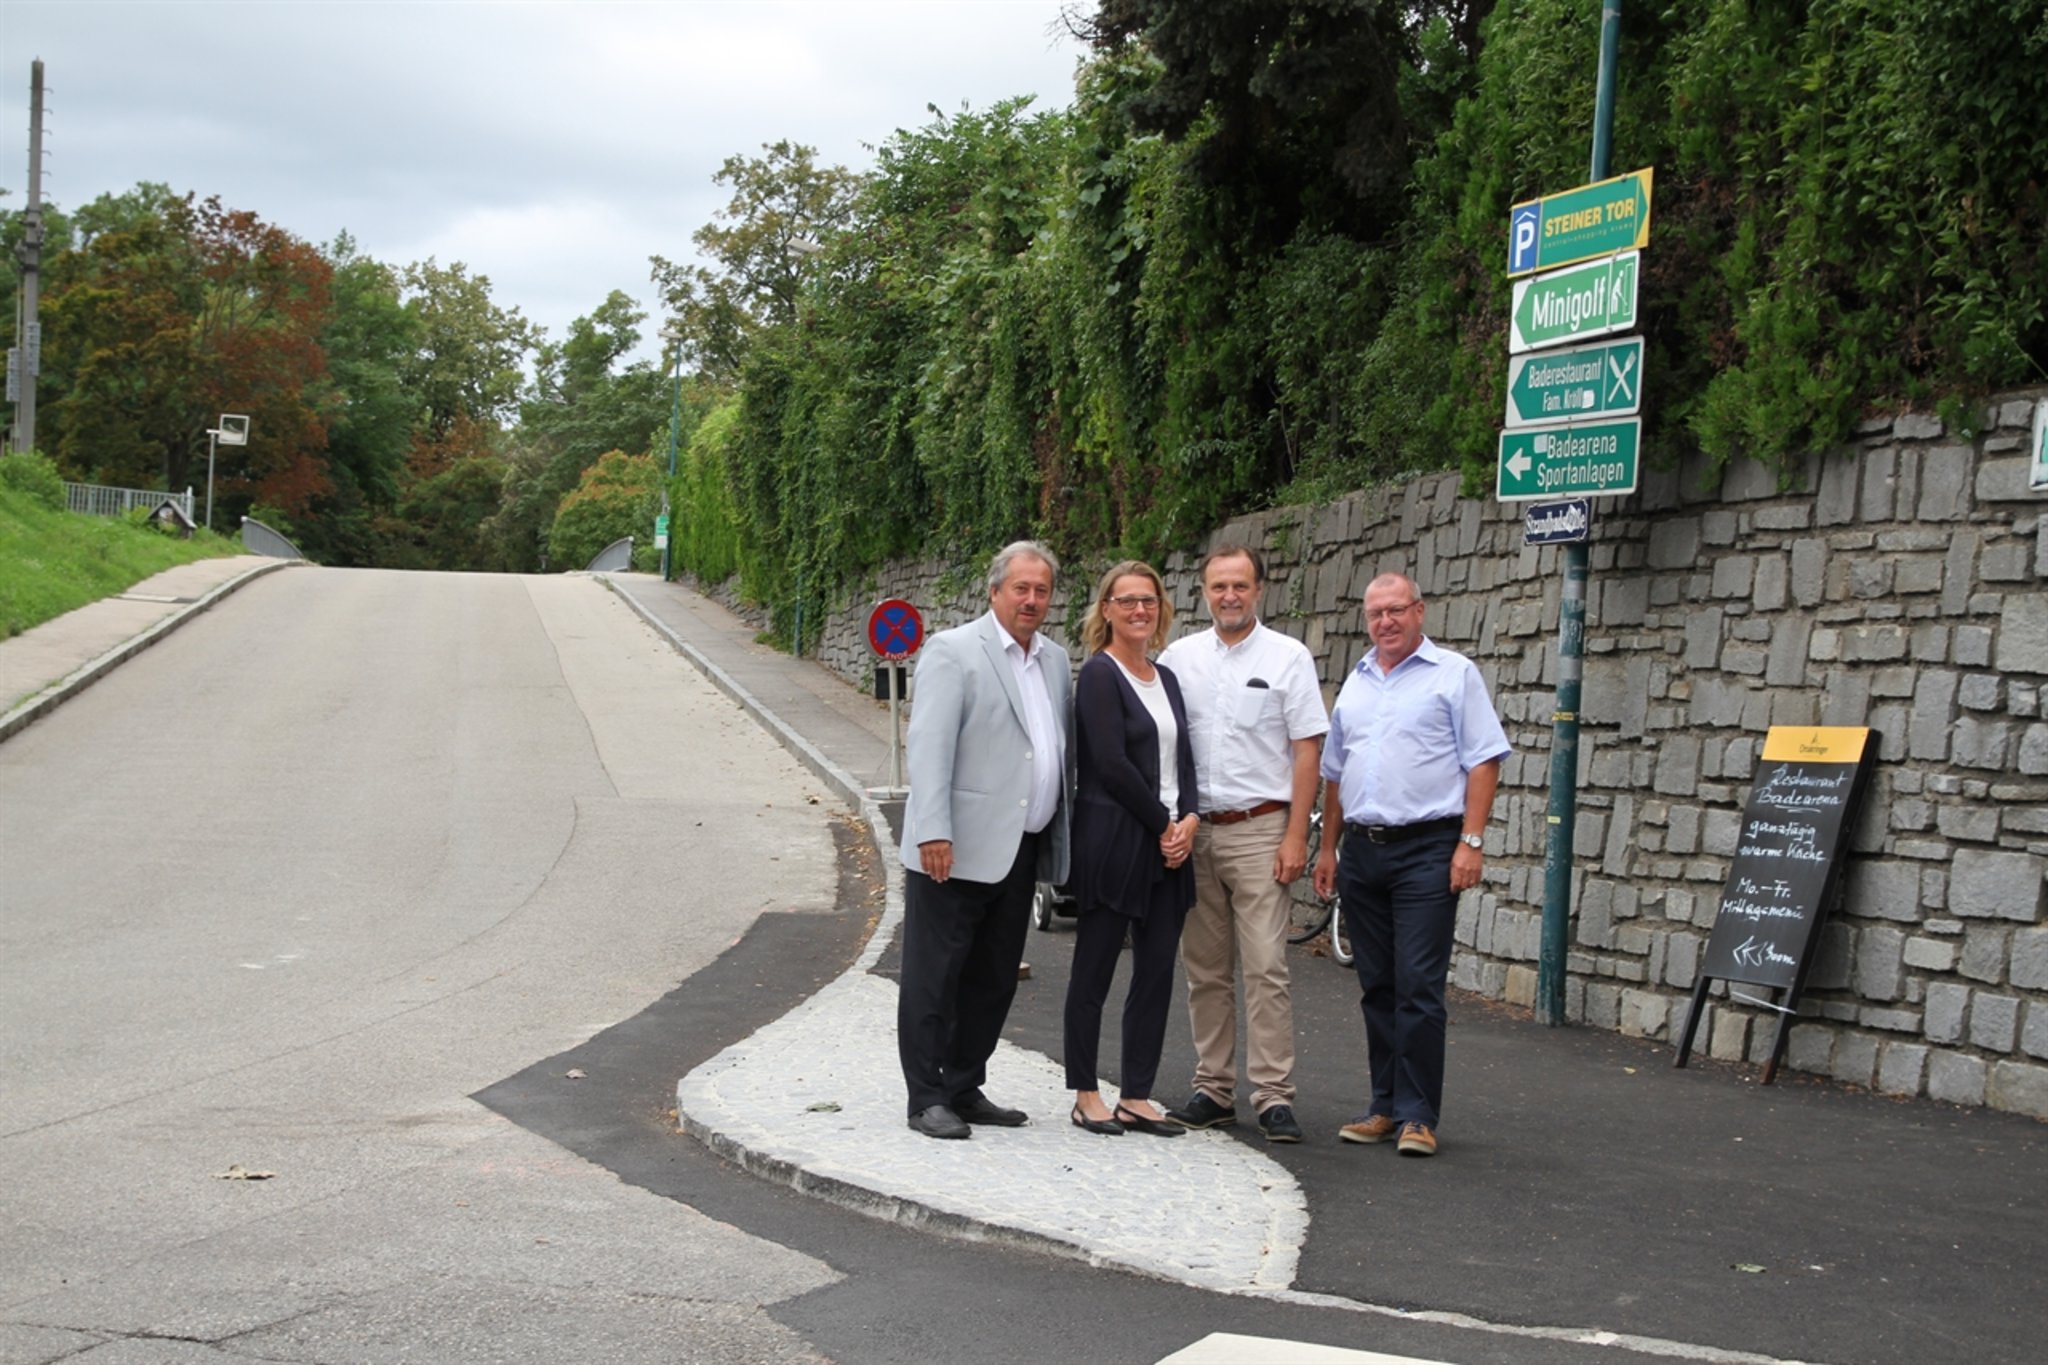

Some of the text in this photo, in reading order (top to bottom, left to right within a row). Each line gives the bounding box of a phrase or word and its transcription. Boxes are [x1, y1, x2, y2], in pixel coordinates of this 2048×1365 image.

[1544, 198, 1635, 238] STEINER TOR
[1514, 221, 1536, 268] P
[1531, 276, 1606, 331] Minigolf
[1528, 356, 1602, 389] Baderestaurant
[1547, 432, 1617, 459] Badearena
[1537, 459, 1624, 492] Sportanlagen
[885, 651, 909, 661] ENDE
[1768, 763, 1848, 787] Restaurant
[1755, 787, 1842, 805] Badearena
[1745, 820, 1816, 845] ganztägig
